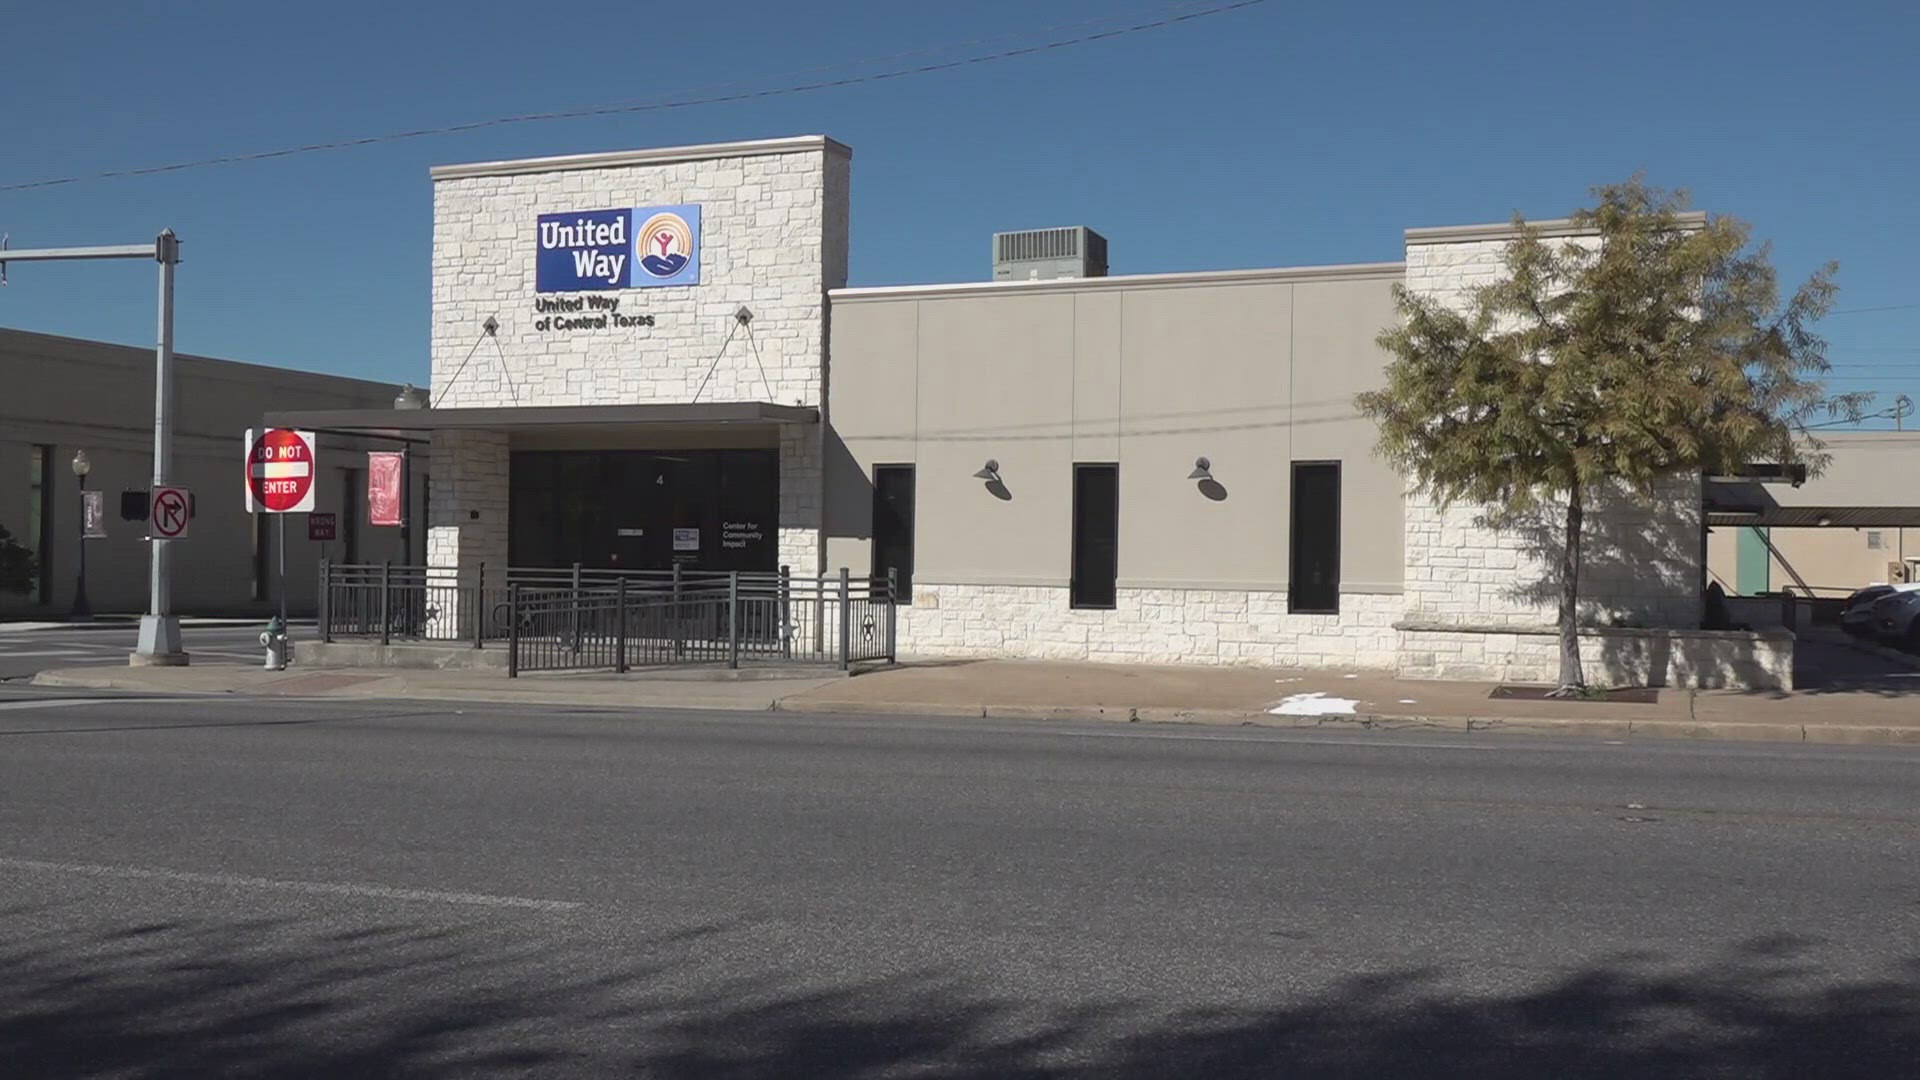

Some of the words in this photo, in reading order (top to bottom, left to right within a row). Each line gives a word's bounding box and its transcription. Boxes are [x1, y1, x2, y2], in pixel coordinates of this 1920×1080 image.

[541, 216, 626, 249] United
[573, 250, 626, 284] Way
[536, 297, 584, 312] United
[588, 295, 619, 312] Way
[535, 316, 551, 331] of
[553, 314, 607, 331] Central
[611, 313, 655, 328] Texas
[258, 446, 273, 459] DO
[279, 446, 302, 459] NOT
[656, 475, 664, 484] 4
[263, 481, 297, 494] ENTER
[310, 516, 335, 526] WRONG
[314, 529, 329, 537] WAY
[723, 532, 763, 540] Community
[723, 540, 745, 548] Impact
